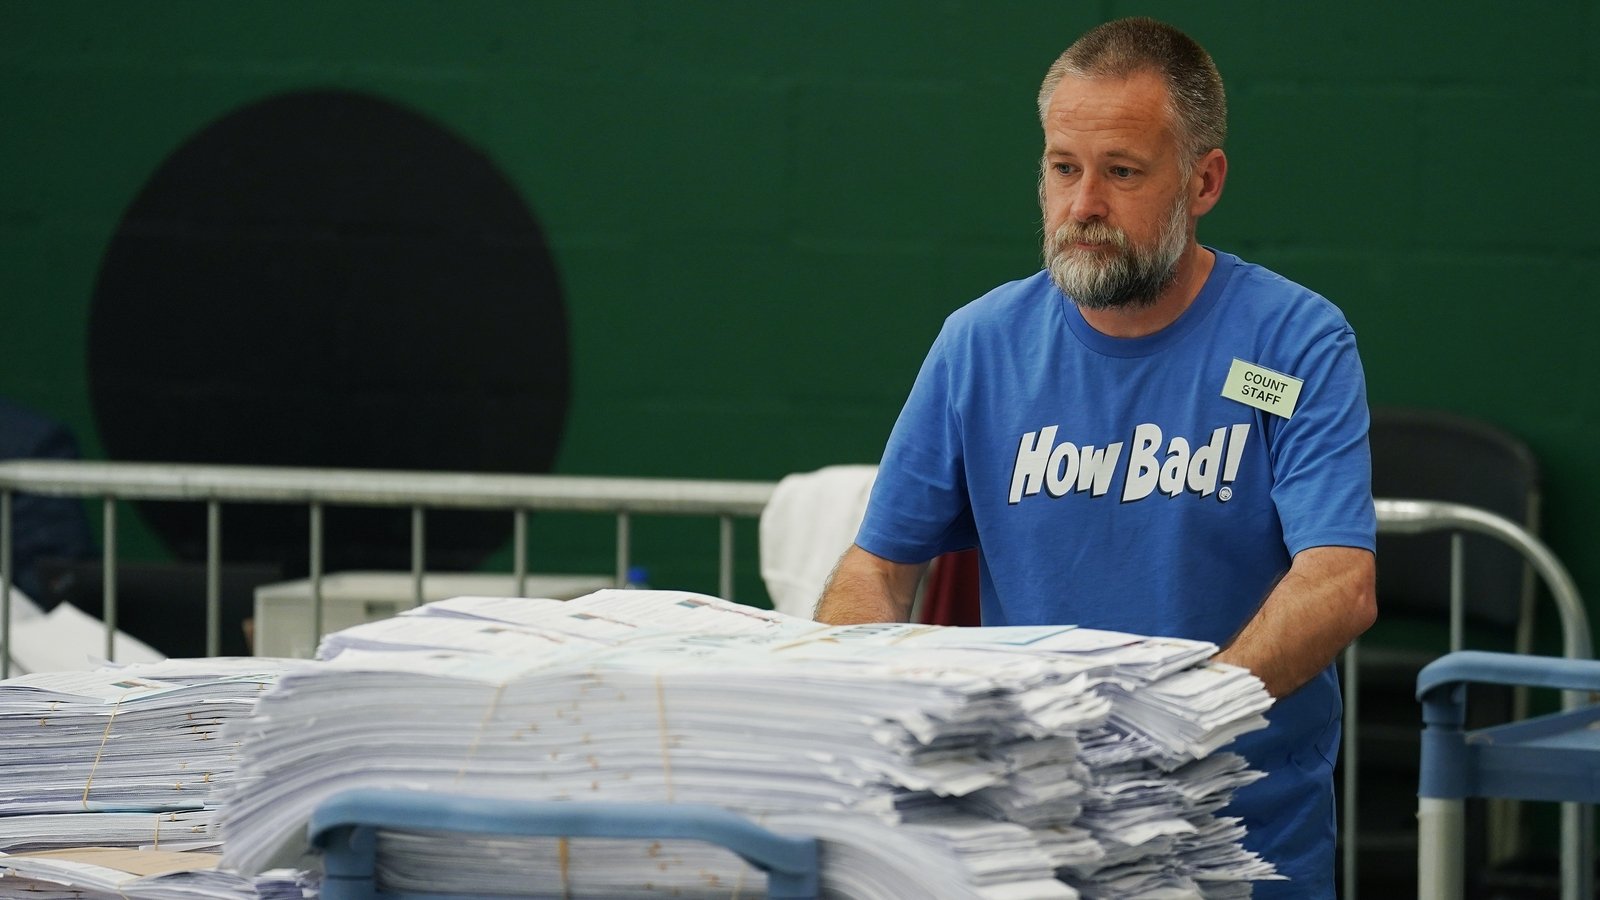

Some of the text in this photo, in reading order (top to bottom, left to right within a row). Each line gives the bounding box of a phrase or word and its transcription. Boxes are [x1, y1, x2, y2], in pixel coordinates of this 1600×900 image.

[1244, 371, 1289, 393] COUNT
[1241, 384, 1282, 405] STAFF
[1009, 423, 1250, 503] How Bad!
